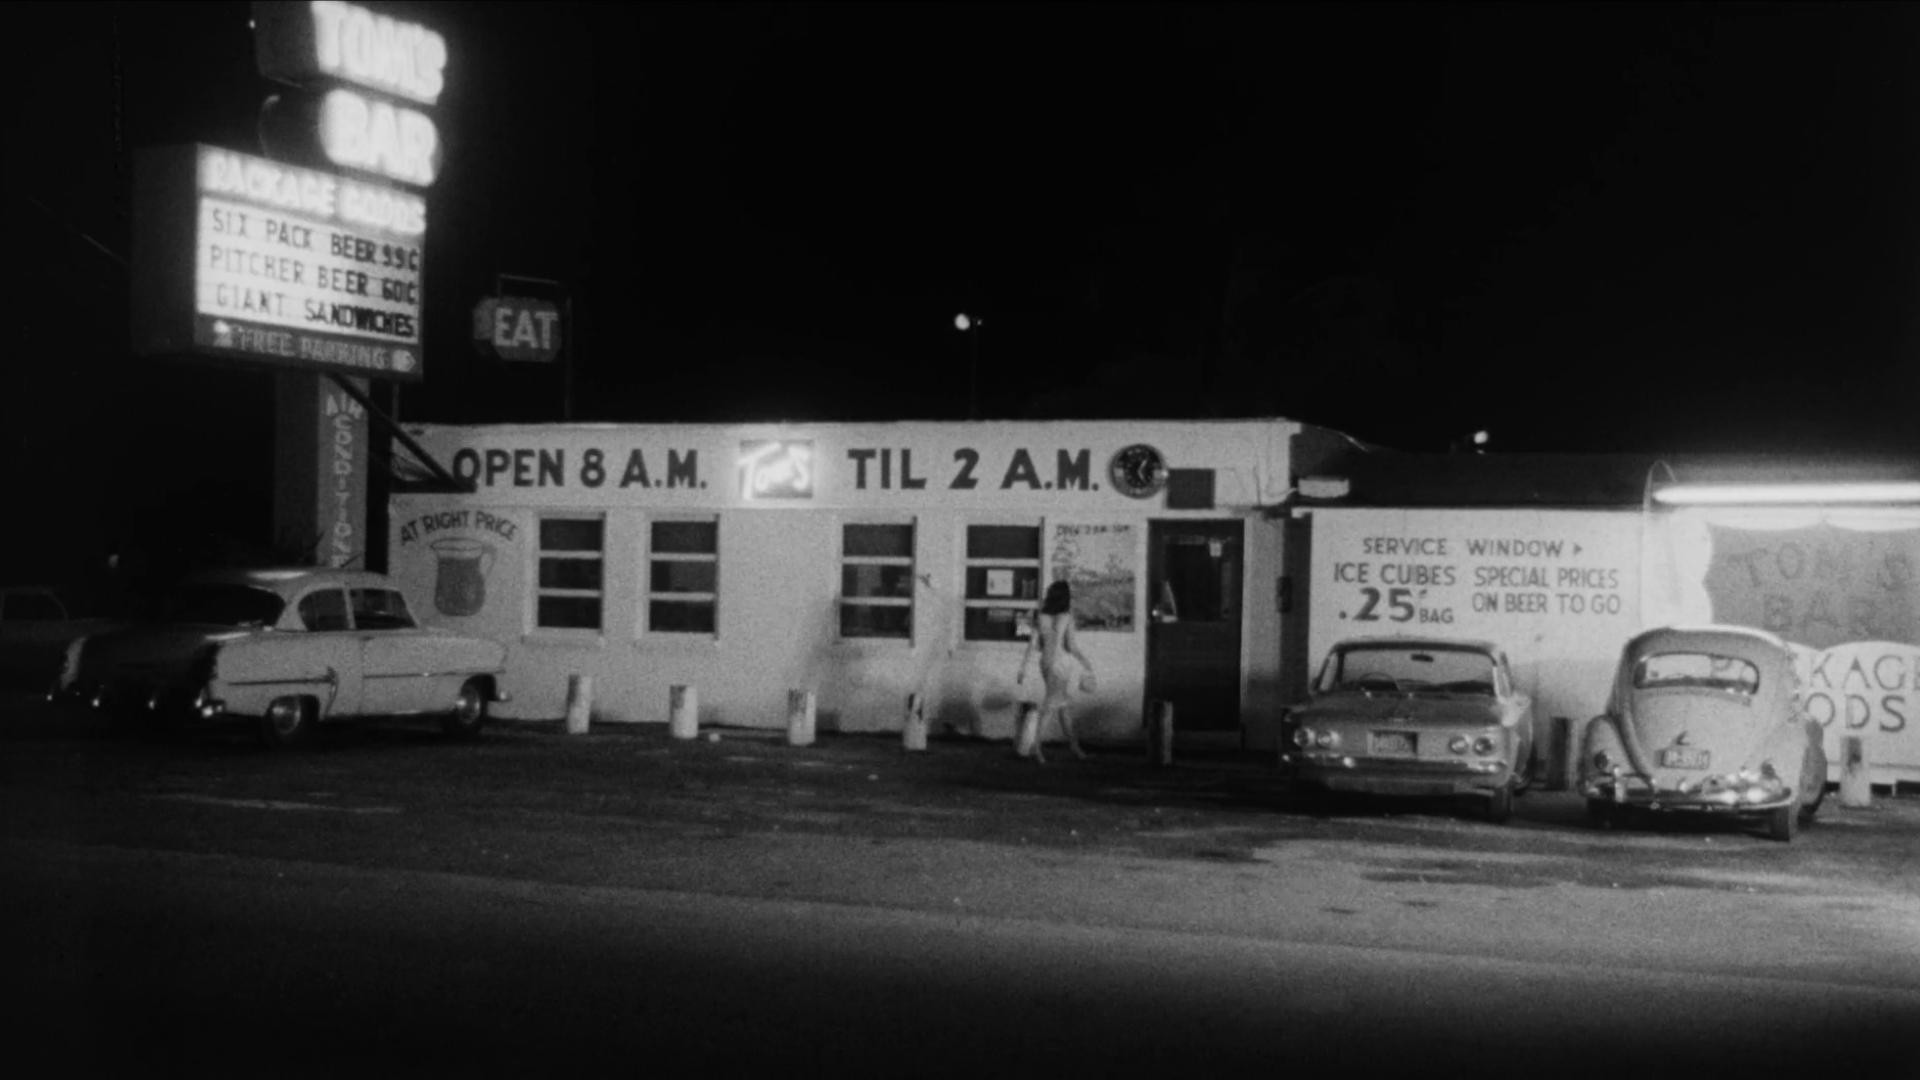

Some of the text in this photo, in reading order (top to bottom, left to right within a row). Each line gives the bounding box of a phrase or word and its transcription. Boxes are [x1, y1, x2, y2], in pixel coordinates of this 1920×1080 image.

[322, 89, 437, 187] BAR
[204, 151, 425, 234] PACKAGE GOODS
[212, 208, 248, 238] SIX
[266, 219, 313, 249] PACK
[330, 233, 376, 264] BEER
[210, 244, 304, 286] PITCHER
[318, 265, 368, 296] BEER
[216, 282, 414, 338] GIANT SANDWICHES
[494, 307, 558, 350] EAT
[240, 326, 388, 369] FREE PARKING
[326, 393, 364, 420] AIR
[452, 447, 708, 490] OPEN 8 A.M.
[847, 448, 1100, 490] TIL 2 A.M.
[401, 510, 519, 546] AT RIGHT PRICE
[1363, 537, 1565, 557] SERVICE WINDOW
[1333, 562, 1456, 586] ICE CUBES
[1473, 565, 1620, 589] SPECIAL PRICES
[1419, 607, 1454, 625] BAG
[1471, 592, 1622, 615] ON BEER TO GO
